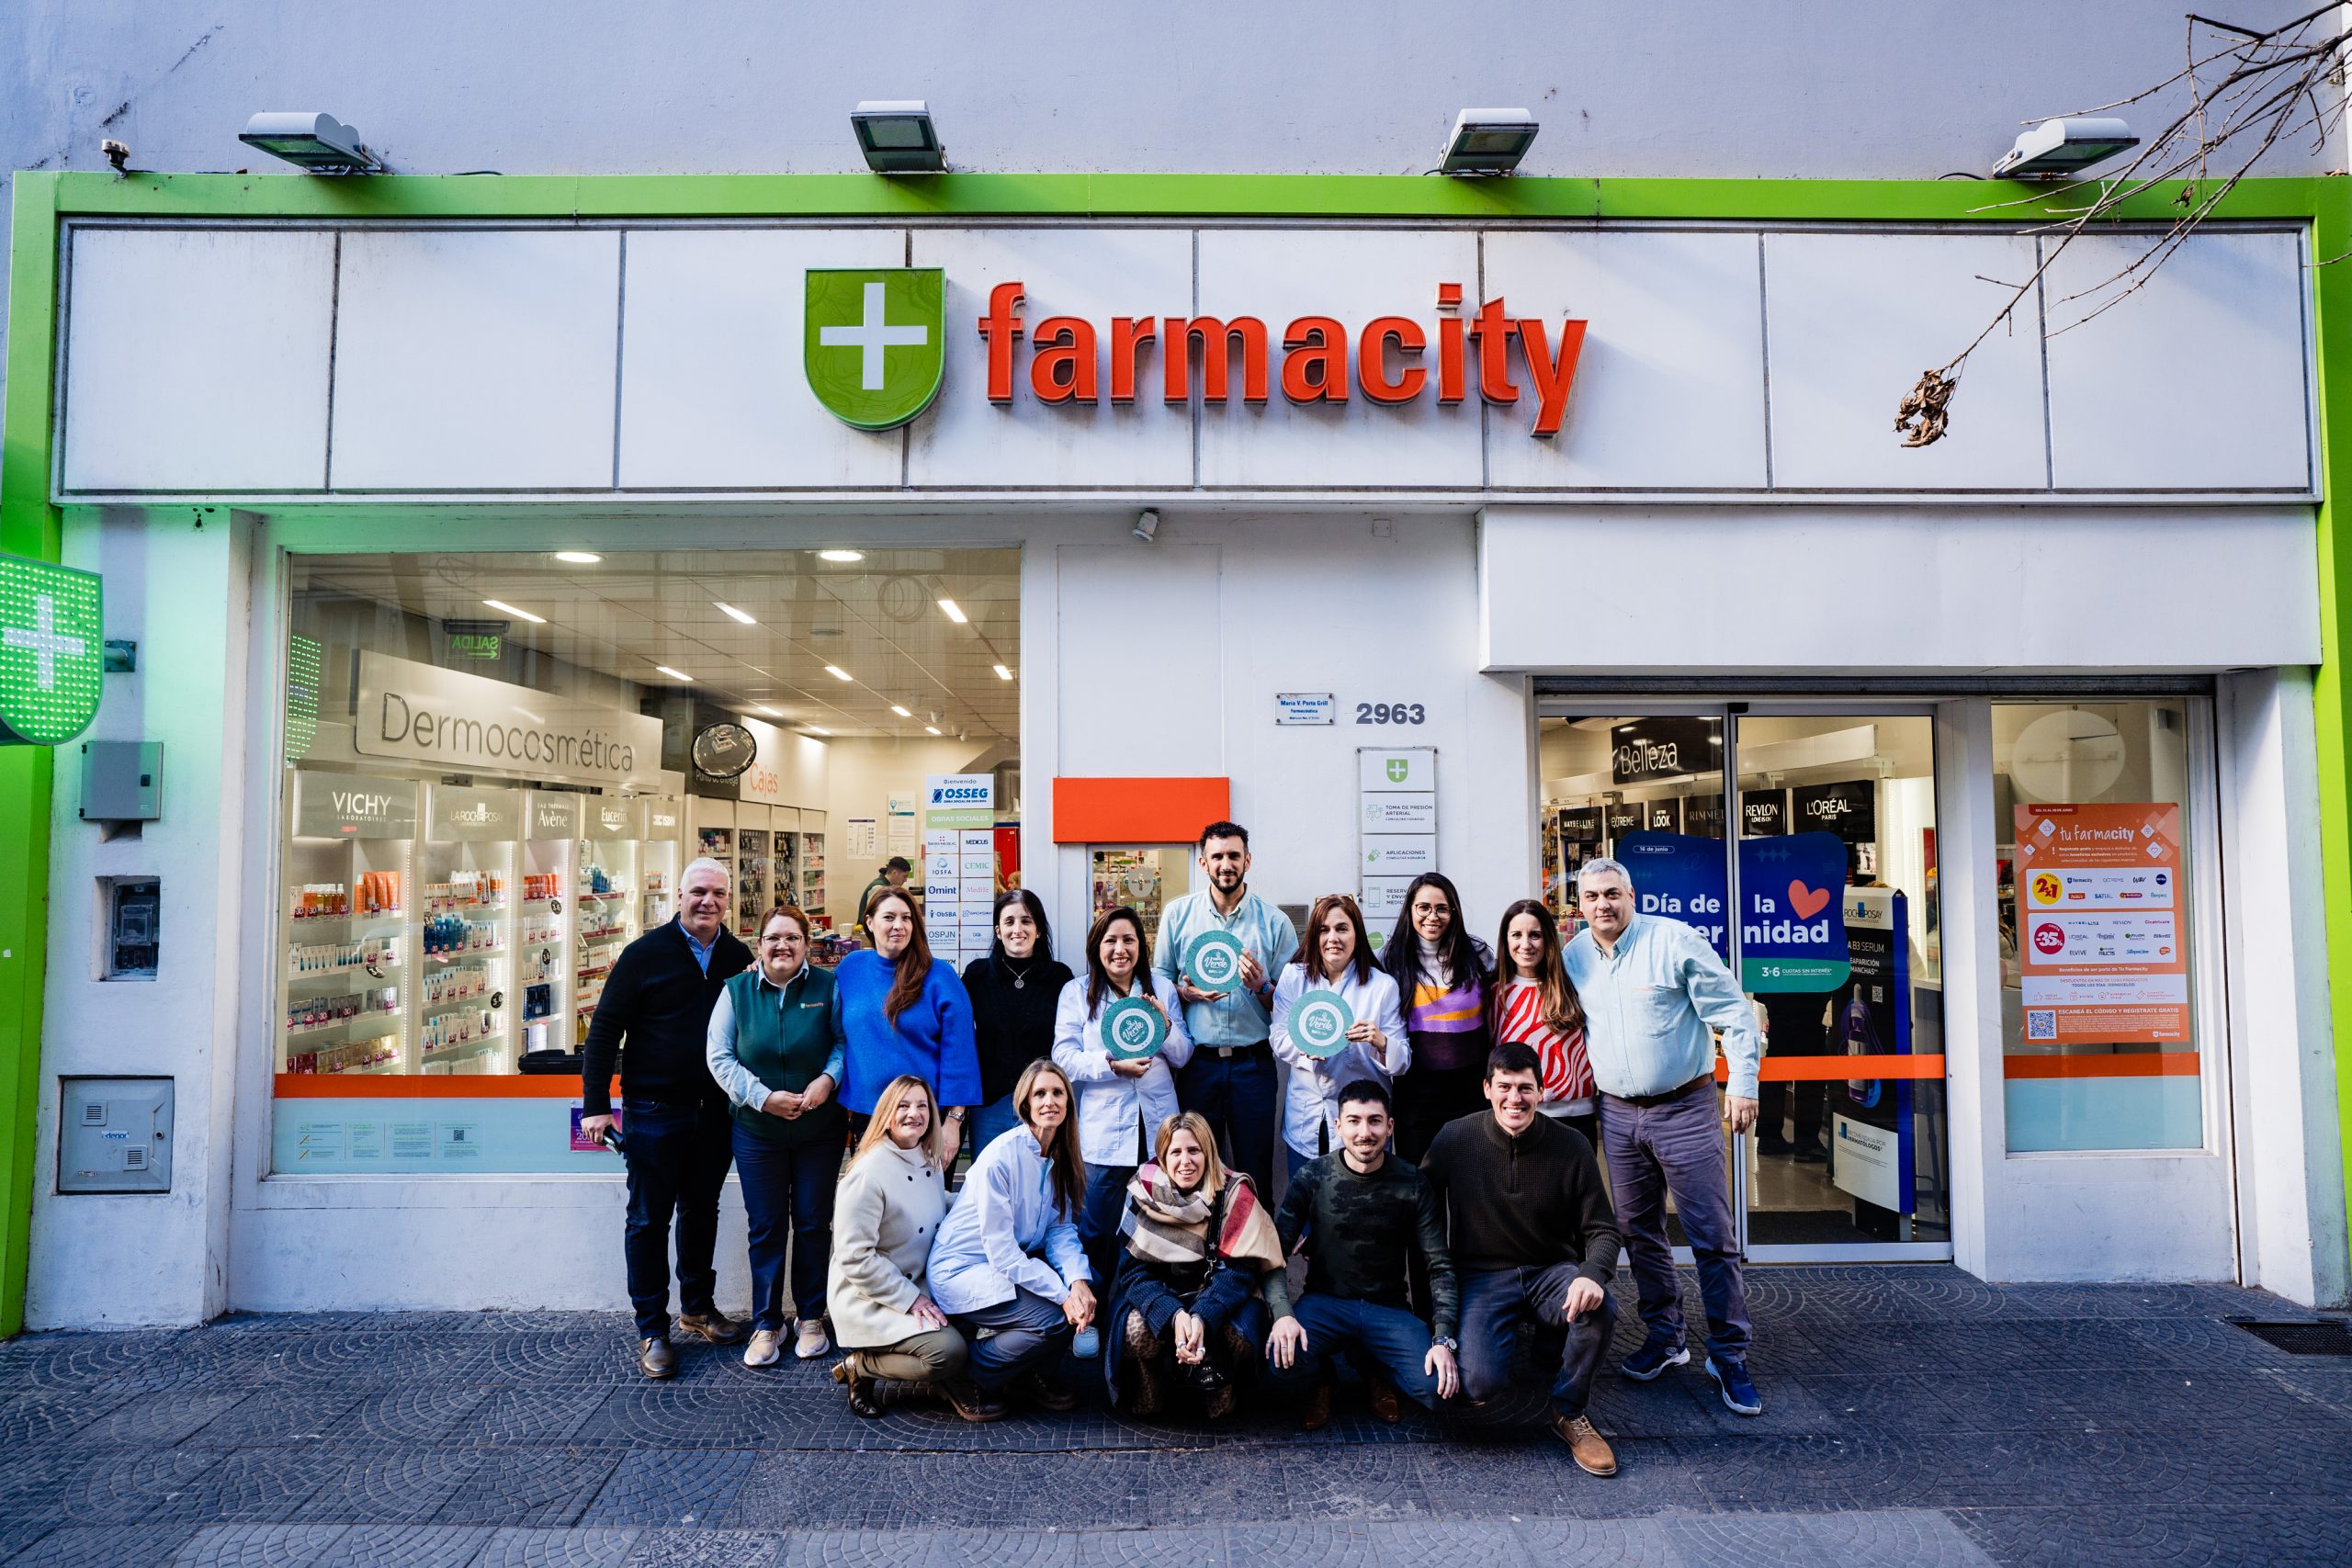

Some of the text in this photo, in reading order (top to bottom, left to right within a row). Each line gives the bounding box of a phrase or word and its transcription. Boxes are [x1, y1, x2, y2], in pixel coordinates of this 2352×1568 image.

[978, 281, 1588, 438] farmacity
[1355, 703, 1426, 725] 2963
[381, 692, 633, 773] Dermocosmética
[1620, 741, 1678, 775] Belleza
[750, 763, 778, 798] Cajas
[944, 788, 989, 798] OSSEG
[332, 791, 391, 816] VICHY
[1746, 804, 1778, 818] REVLON
[1806, 797, 1852, 816] L'ORÉAL
[537, 809, 568, 827] Avène
[601, 807, 628, 823] Eucerin
[1653, 815, 1670, 827] LOOK
[2060, 824, 2134, 843] tu farmacity
[2036, 878, 2058, 898] 2x1
[1642, 893, 1776, 913] Día de la
[1865, 909, 1883, 919] POSAY
[1852, 941, 1860, 951] B3
[1861, 942, 1884, 953] SERUM
[1849, 957, 1880, 967] EAPARICIÓN
